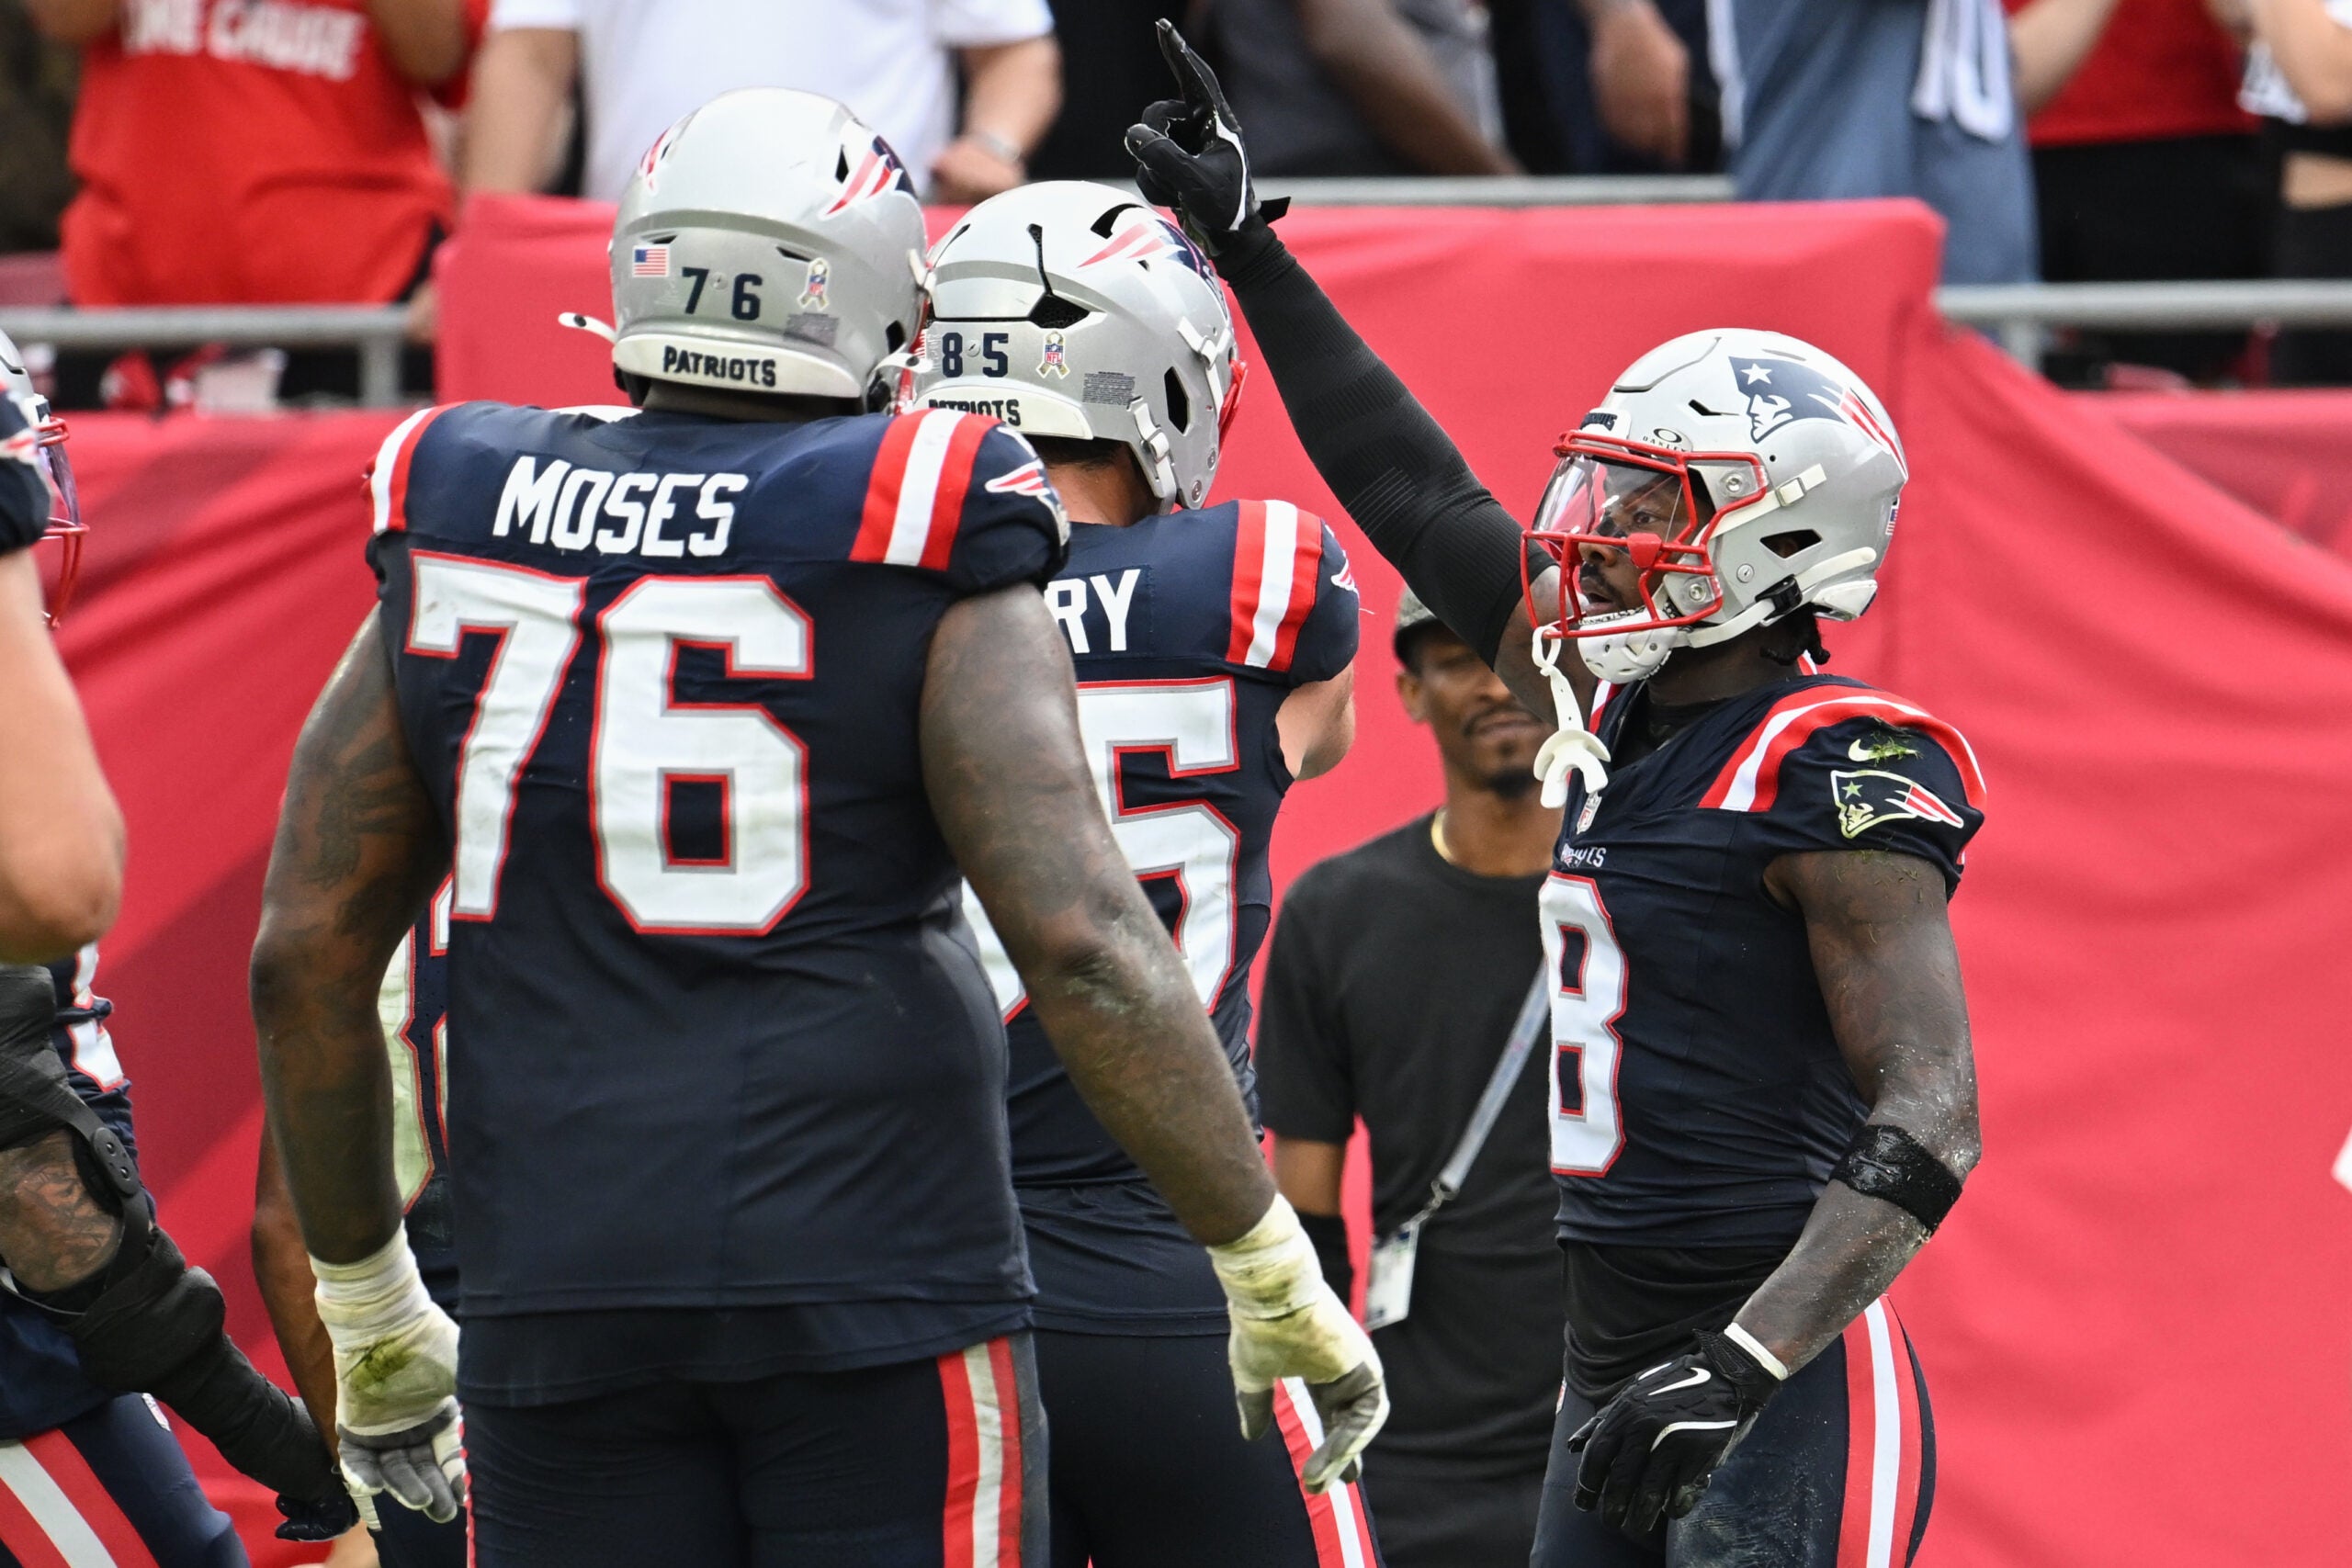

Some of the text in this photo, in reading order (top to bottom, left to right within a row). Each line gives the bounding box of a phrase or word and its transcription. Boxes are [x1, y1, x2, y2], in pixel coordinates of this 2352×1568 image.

[662, 344, 776, 387] PATRIOTS
[492, 456, 749, 558] MOSES
[404, 548, 814, 936] 76
[1538, 870, 1630, 1178] 8
